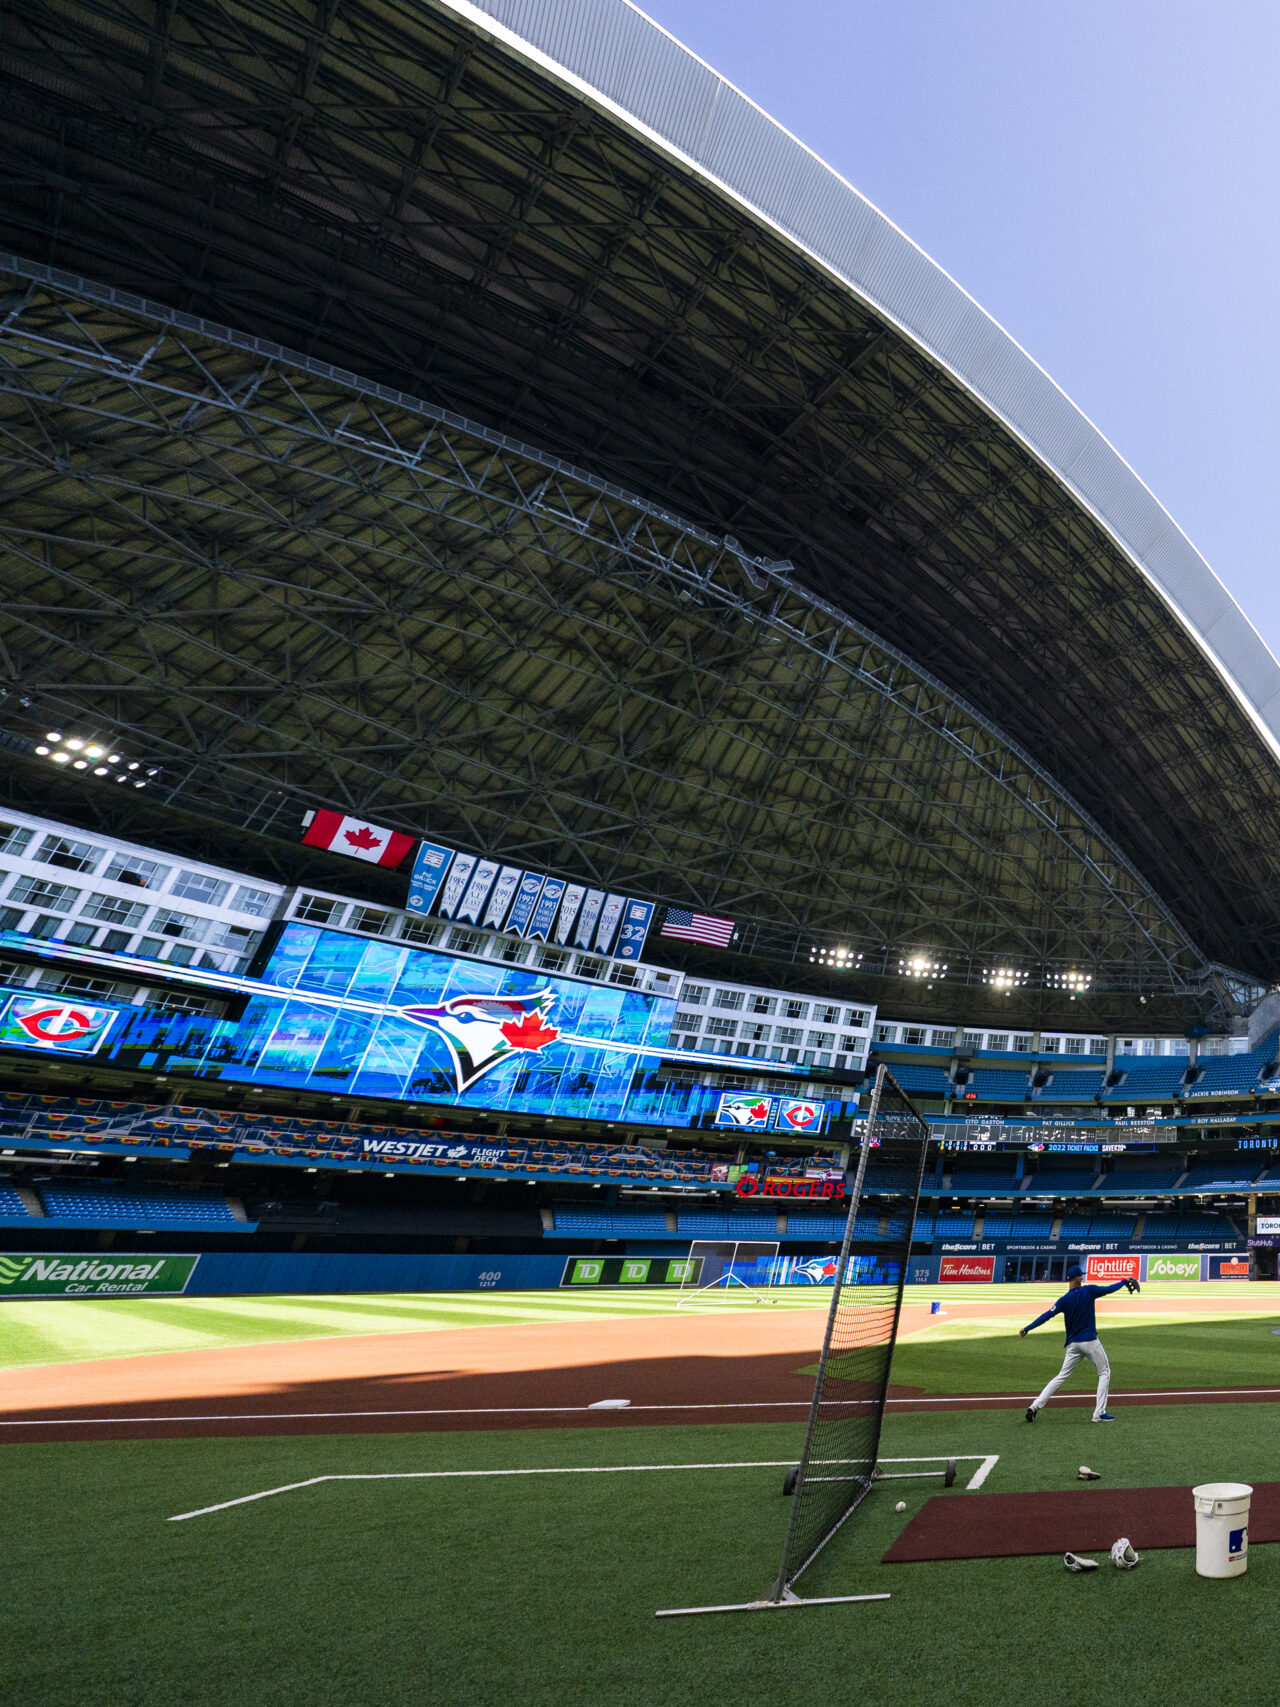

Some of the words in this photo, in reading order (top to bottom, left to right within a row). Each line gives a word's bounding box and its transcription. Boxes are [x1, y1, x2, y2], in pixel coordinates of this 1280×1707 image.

[448, 875, 466, 886] 1985
[471, 881, 489, 892] 1989
[495, 887, 512, 899] 1991
[518, 893, 535, 905] 1992
[465, 897, 481, 907] EAST
[540, 899, 556, 910] 1993
[560, 904, 577, 916] 2015
[621, 924, 646, 942] 32
[363, 1139, 453, 1158] WESTJET
[471, 1147, 506, 1157] FLIGHT
[1238, 1138, 1278, 1149] TORONTO
[763, 1180, 847, 1199] ROGERS
[942, 1243, 977, 1251] theScore
[20, 1259, 166, 1281] National
[578, 1263, 600, 1279] TD
[624, 1263, 647, 1279] TD
[672, 1263, 692, 1279] TD
[914, 1269, 930, 1277] 375
[943, 1264, 957, 1275] Tim
[958, 1264, 991, 1275] Hortons
[1090, 1259, 1134, 1278] Lightlife
[1150, 1259, 1198, 1277] Sobeys
[478, 1271, 501, 1281] 400
[64, 1282, 94, 1293] Car
[96, 1282, 148, 1292] Rental
